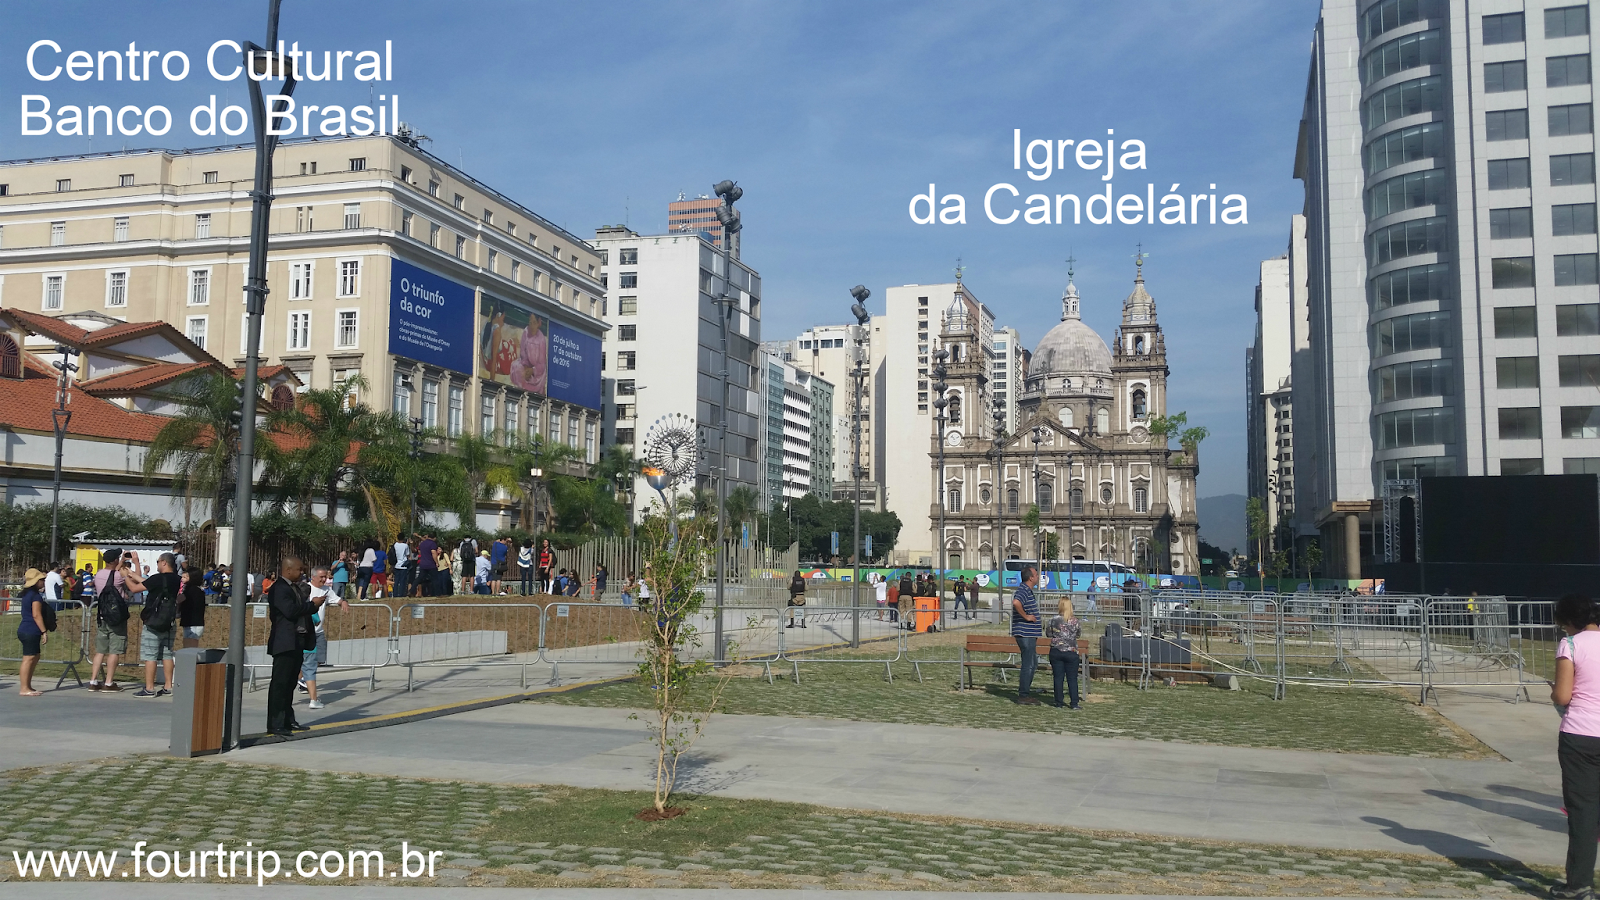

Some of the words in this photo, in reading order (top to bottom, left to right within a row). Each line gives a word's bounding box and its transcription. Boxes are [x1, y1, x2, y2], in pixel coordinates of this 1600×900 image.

[401, 277, 409, 293] O
[412, 283, 445, 307] triunfo
[400, 296, 413, 313] da
[415, 304, 432, 319] cor
[553, 334, 559, 343] 20
[560, 336, 565, 346] de
[565, 338, 576, 350] julho
[553, 345, 558, 353] 17
[558, 346, 564, 356] de
[565, 350, 582, 362] outubro
[553, 355, 559, 365] de
